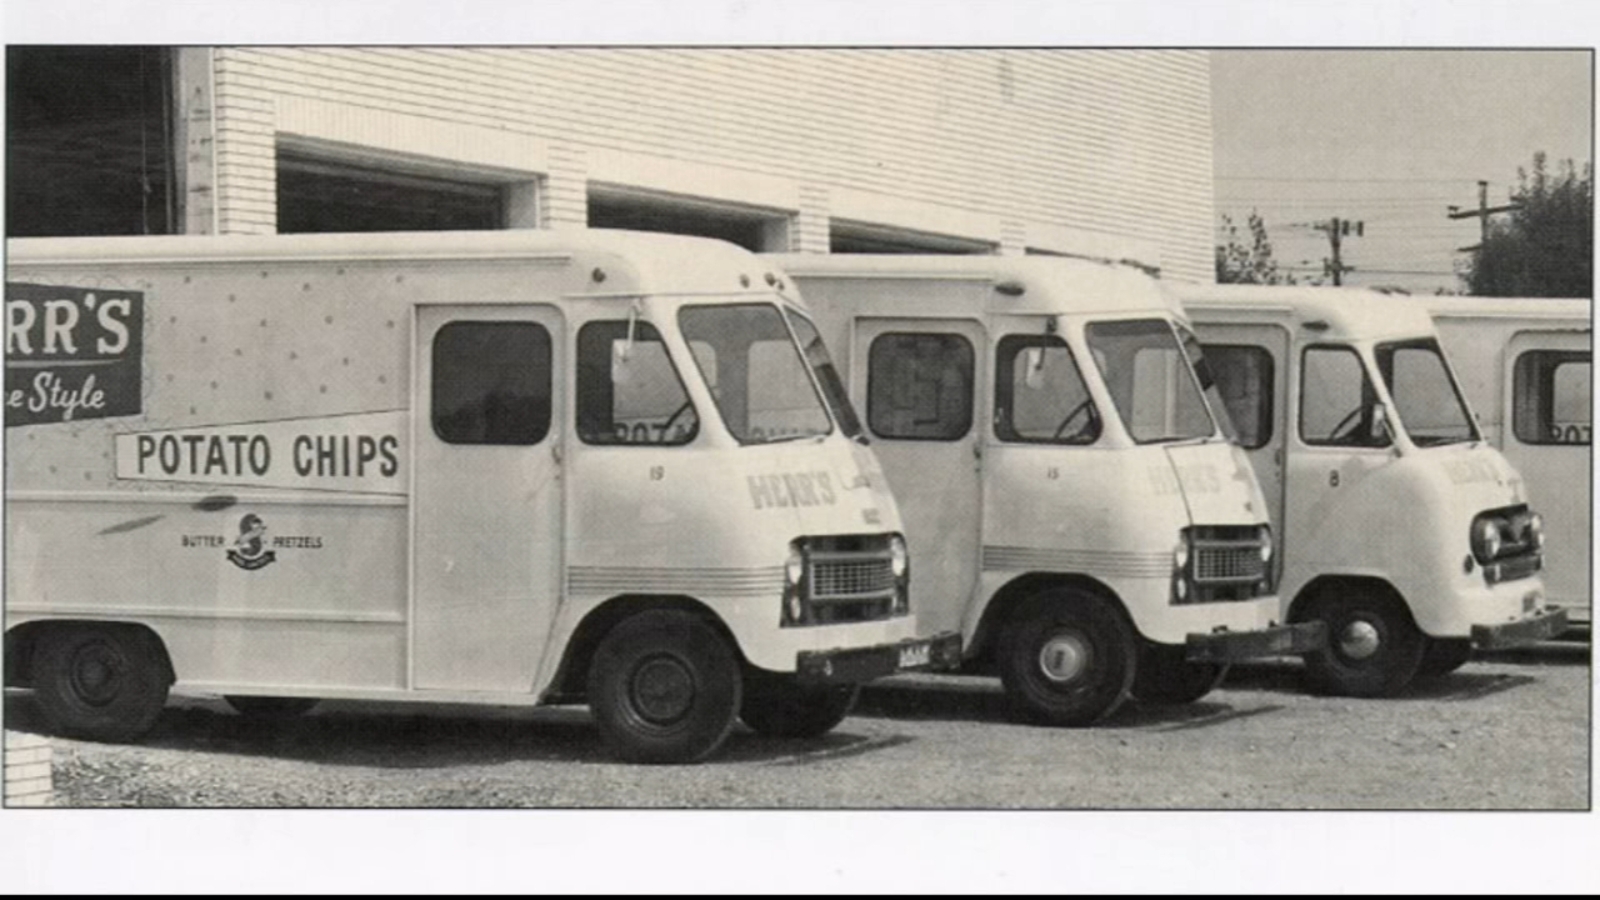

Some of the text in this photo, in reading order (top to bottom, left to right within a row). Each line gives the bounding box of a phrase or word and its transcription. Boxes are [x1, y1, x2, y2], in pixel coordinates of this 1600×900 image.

[28, 371, 106, 420] Style
[137, 434, 399, 477] POTATO CHIPS
[746, 470, 837, 510] HERR'S
[1329, 469, 1341, 488] 8
[181, 535, 323, 549] BUTTER PRETZELS
